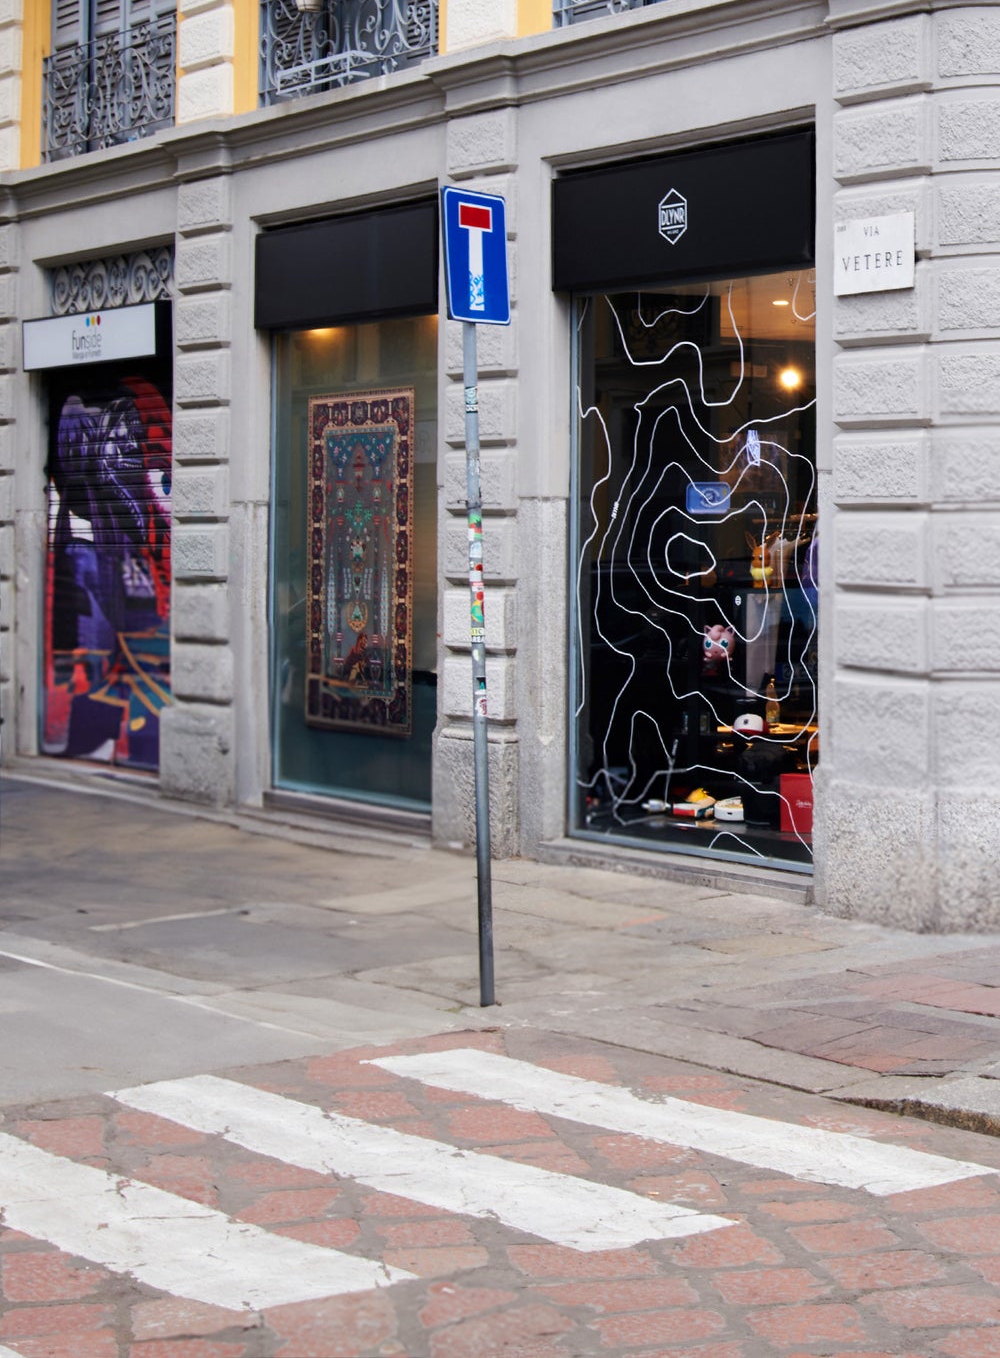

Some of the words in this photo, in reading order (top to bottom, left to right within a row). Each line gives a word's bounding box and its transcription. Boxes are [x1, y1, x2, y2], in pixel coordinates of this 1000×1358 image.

[661, 207, 685, 226] DLYNR
[863, 226, 880, 237] VIA
[842, 250, 903, 271] VETERE
[72, 327, 102, 351] funside
